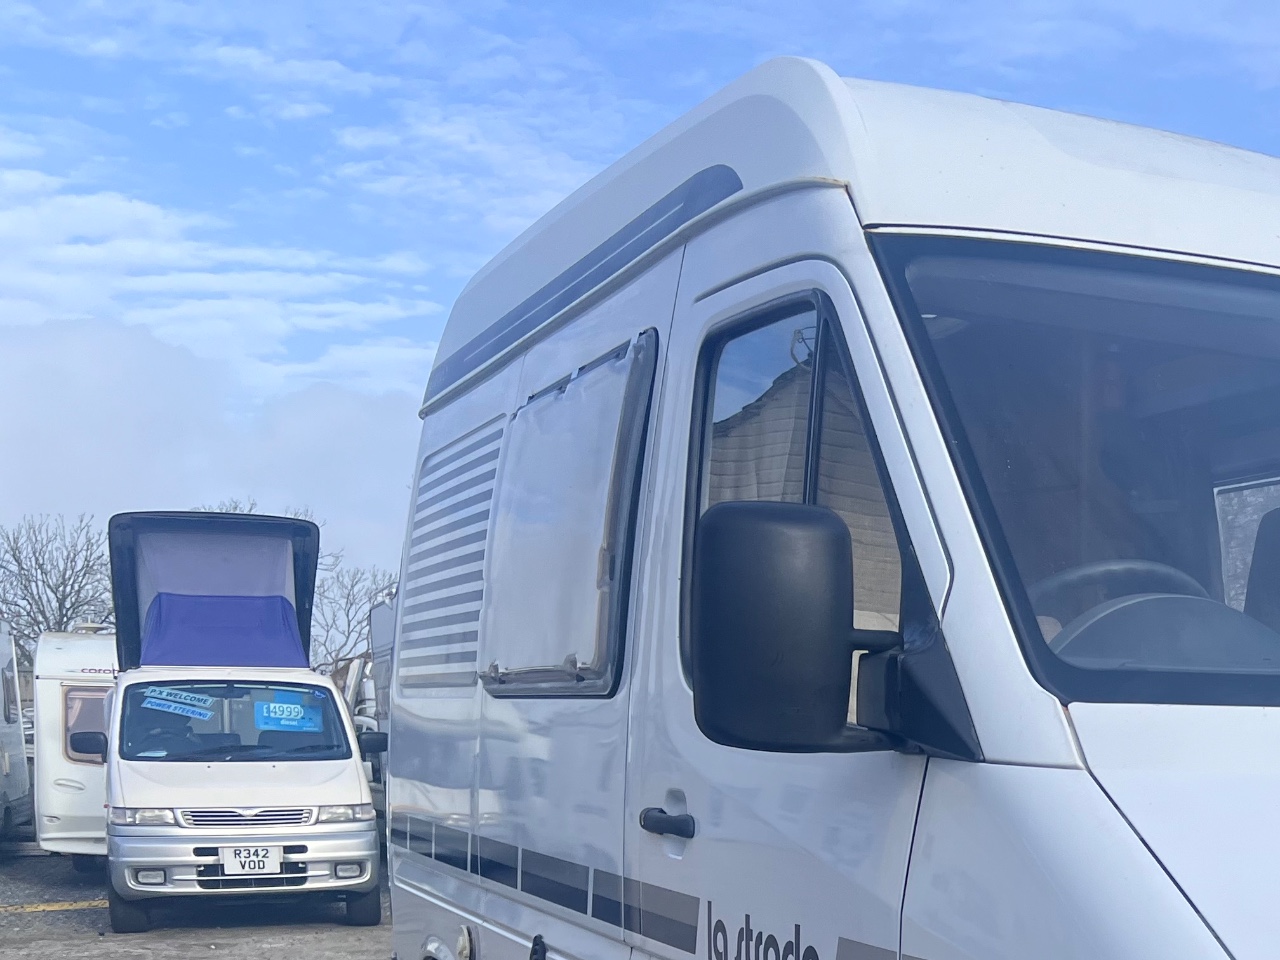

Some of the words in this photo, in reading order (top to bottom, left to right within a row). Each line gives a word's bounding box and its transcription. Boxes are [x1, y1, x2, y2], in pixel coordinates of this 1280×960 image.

[165, 691, 210, 705] WELCOME
[146, 700, 171, 710] POWER
[173, 705, 209, 719] STEERING
[234, 848, 270, 859] R342
[239, 859, 266, 870] VOD
